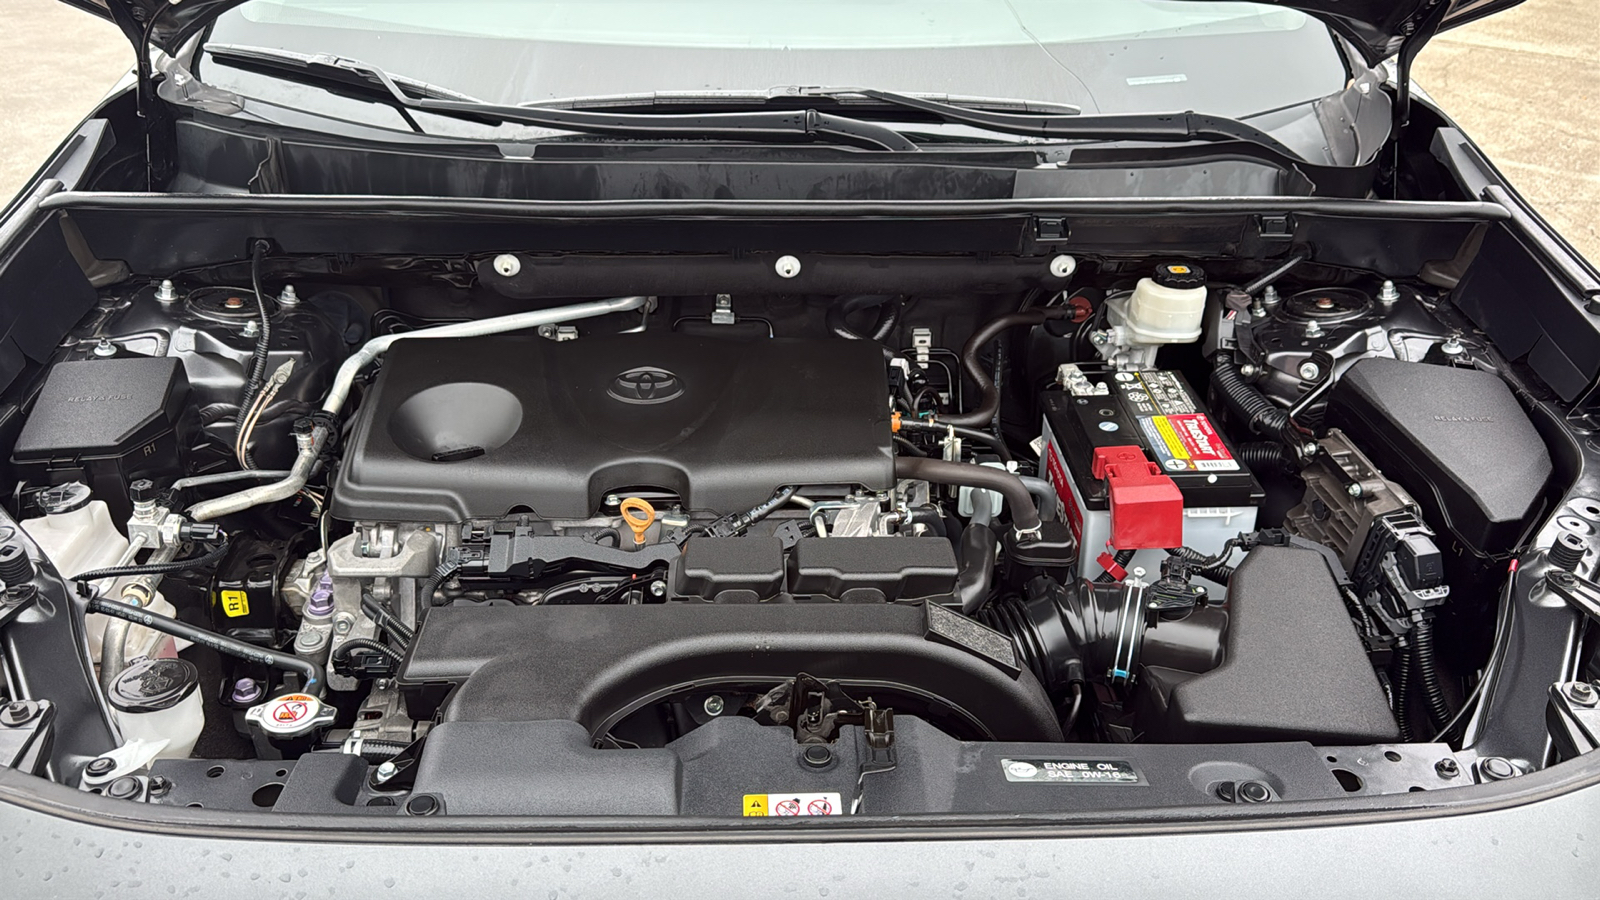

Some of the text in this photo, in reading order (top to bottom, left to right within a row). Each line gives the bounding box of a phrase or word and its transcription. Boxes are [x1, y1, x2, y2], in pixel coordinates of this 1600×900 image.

[143, 442, 156, 456] R1
[227, 596, 240, 612] R1
[1043, 762, 1119, 771] ENGINE OIL
[1047, 770, 1074, 778] SAE
